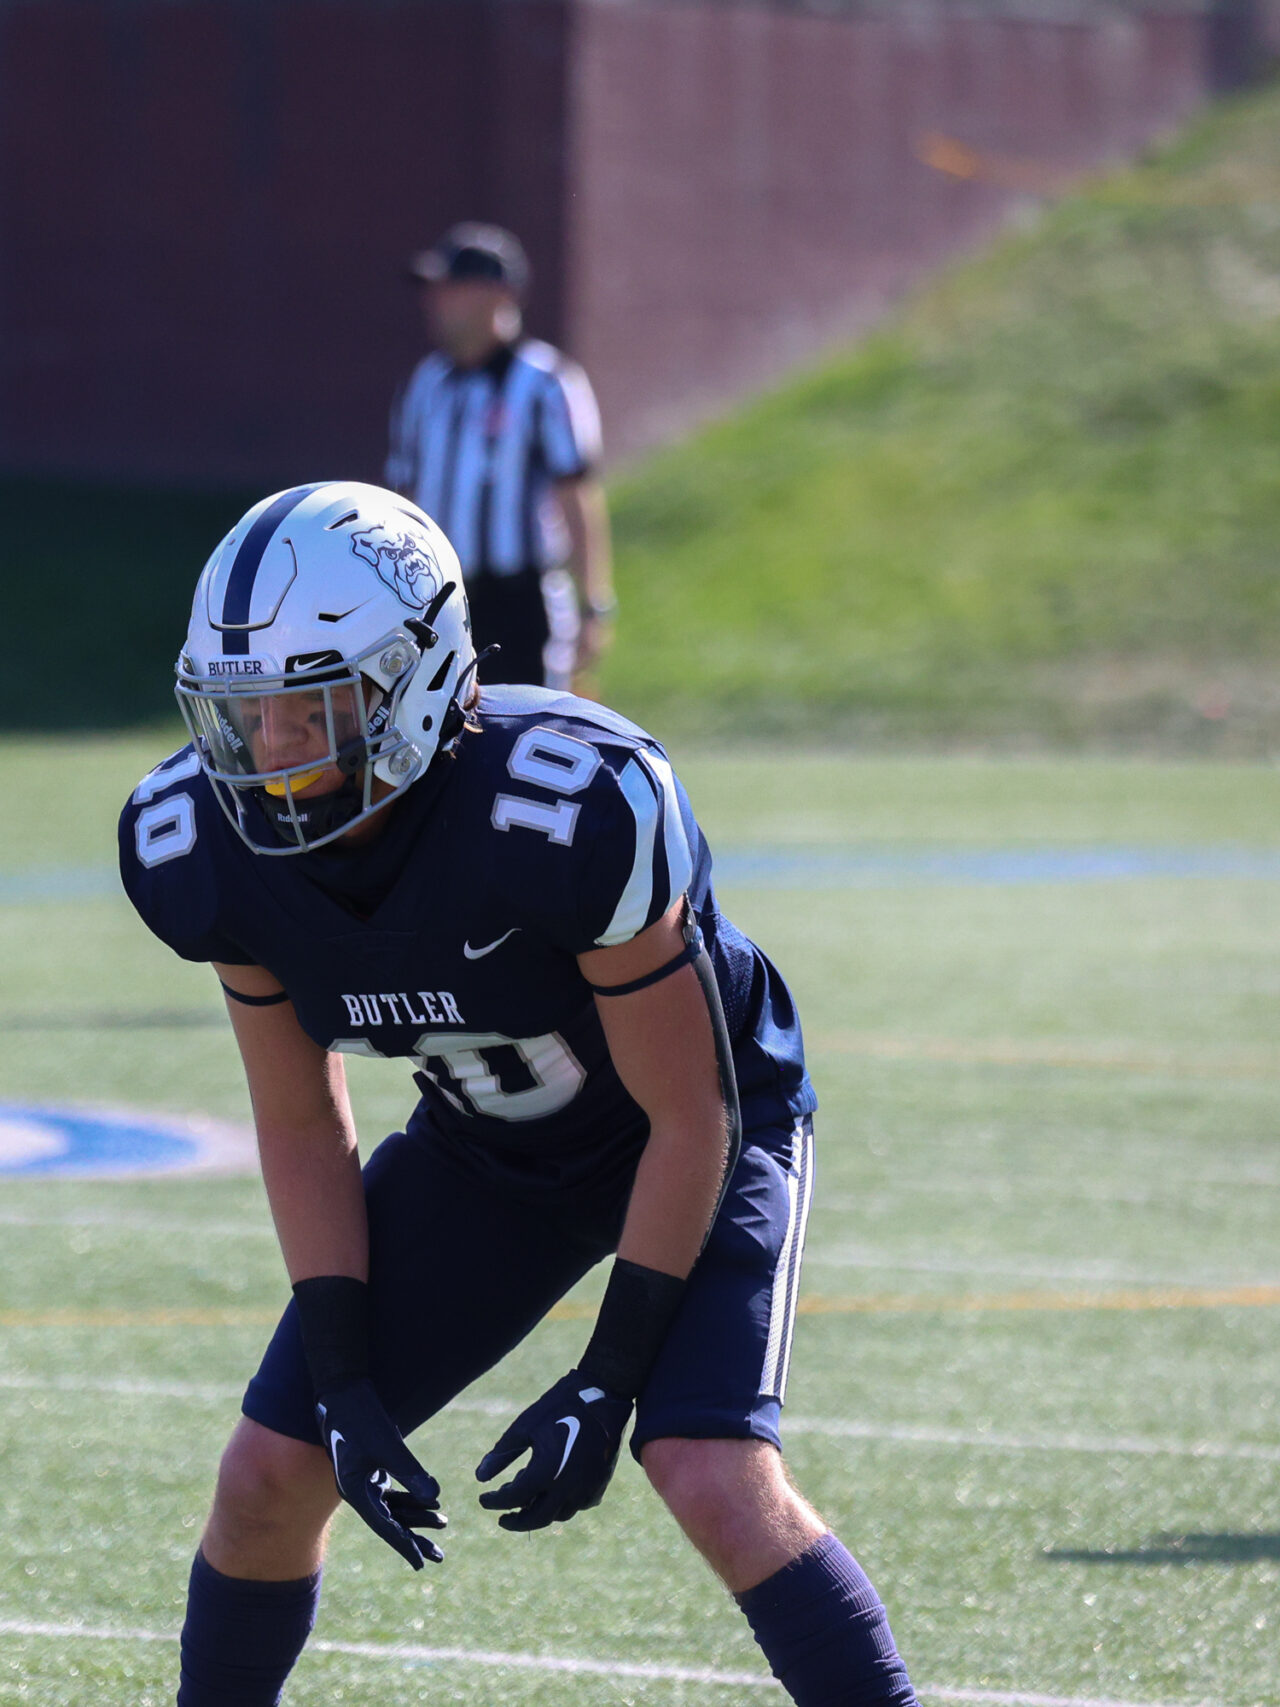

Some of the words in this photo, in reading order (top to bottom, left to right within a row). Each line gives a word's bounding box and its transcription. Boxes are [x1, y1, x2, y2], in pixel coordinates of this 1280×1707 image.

[208, 660, 264, 676] BUTLER
[368, 705, 390, 735] dell
[132, 751, 199, 869] 10
[490, 725, 602, 847] 10
[341, 991, 466, 1026] BUTLER
[327, 1031, 588, 1122] 0
